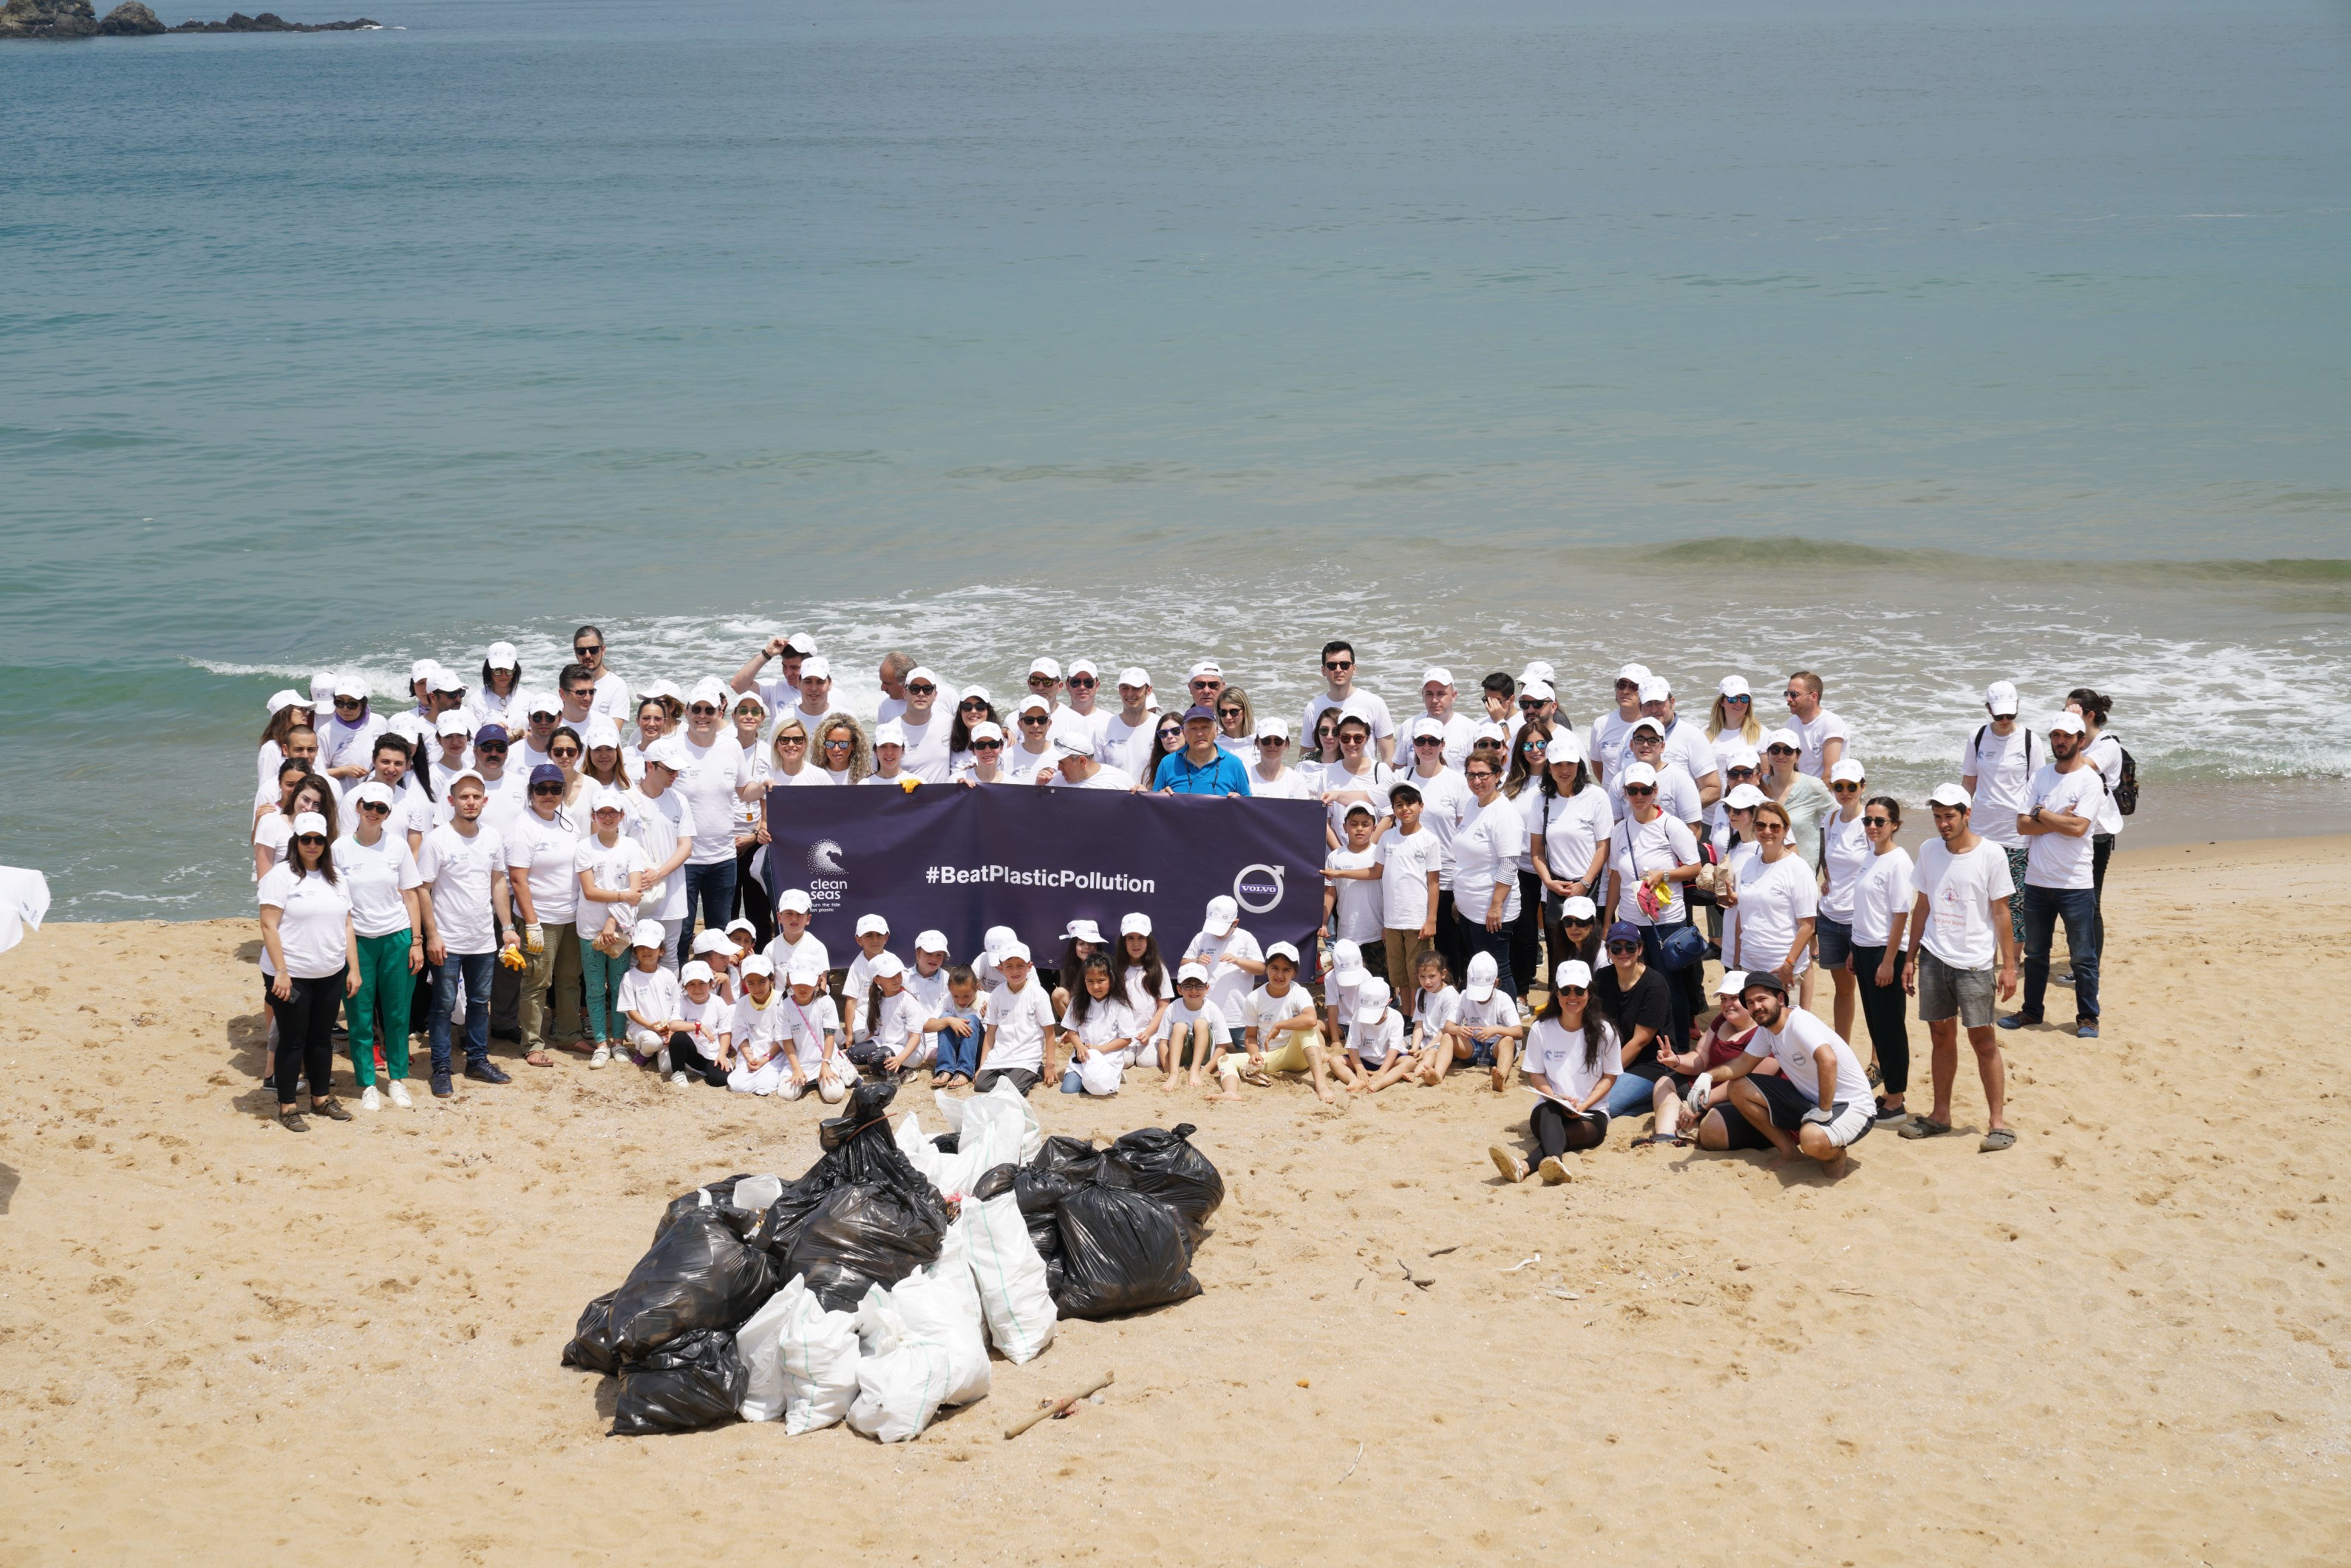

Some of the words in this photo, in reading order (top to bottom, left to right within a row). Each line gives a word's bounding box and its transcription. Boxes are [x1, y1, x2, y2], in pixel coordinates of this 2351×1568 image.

[810, 878, 848, 890] clean
[925, 865, 1155, 893] #BeatPlasticPollution
[810, 890, 841, 900] seas
